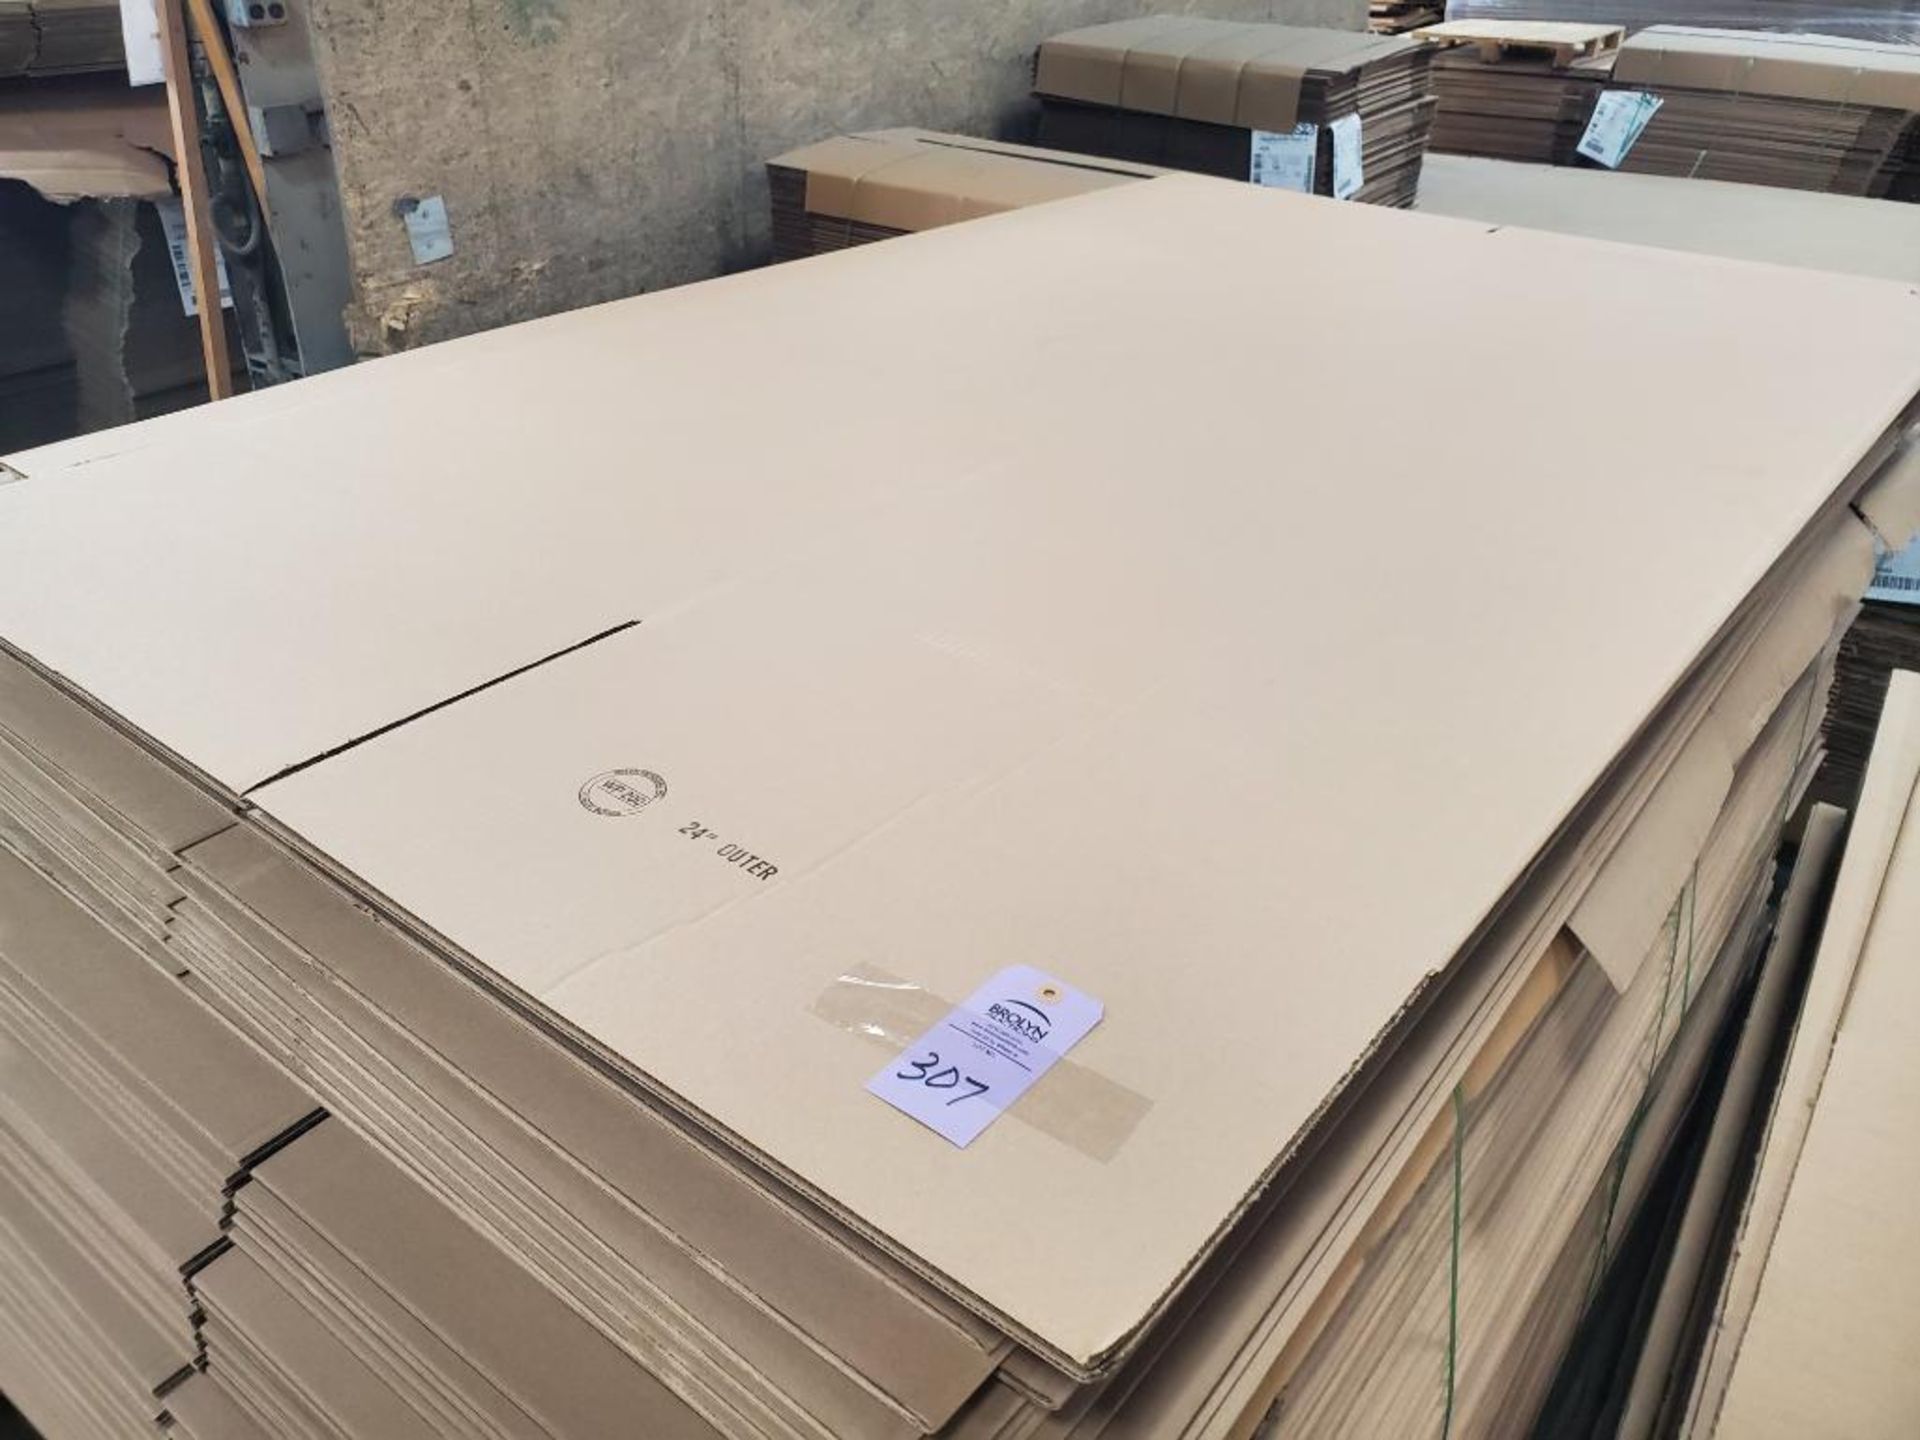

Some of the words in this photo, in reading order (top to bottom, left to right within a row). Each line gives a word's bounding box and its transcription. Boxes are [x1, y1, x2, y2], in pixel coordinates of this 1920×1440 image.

[716, 843, 779, 881] OUTER
[988, 1003, 1049, 1041] BROLYN
[896, 1051, 990, 1107] 307
